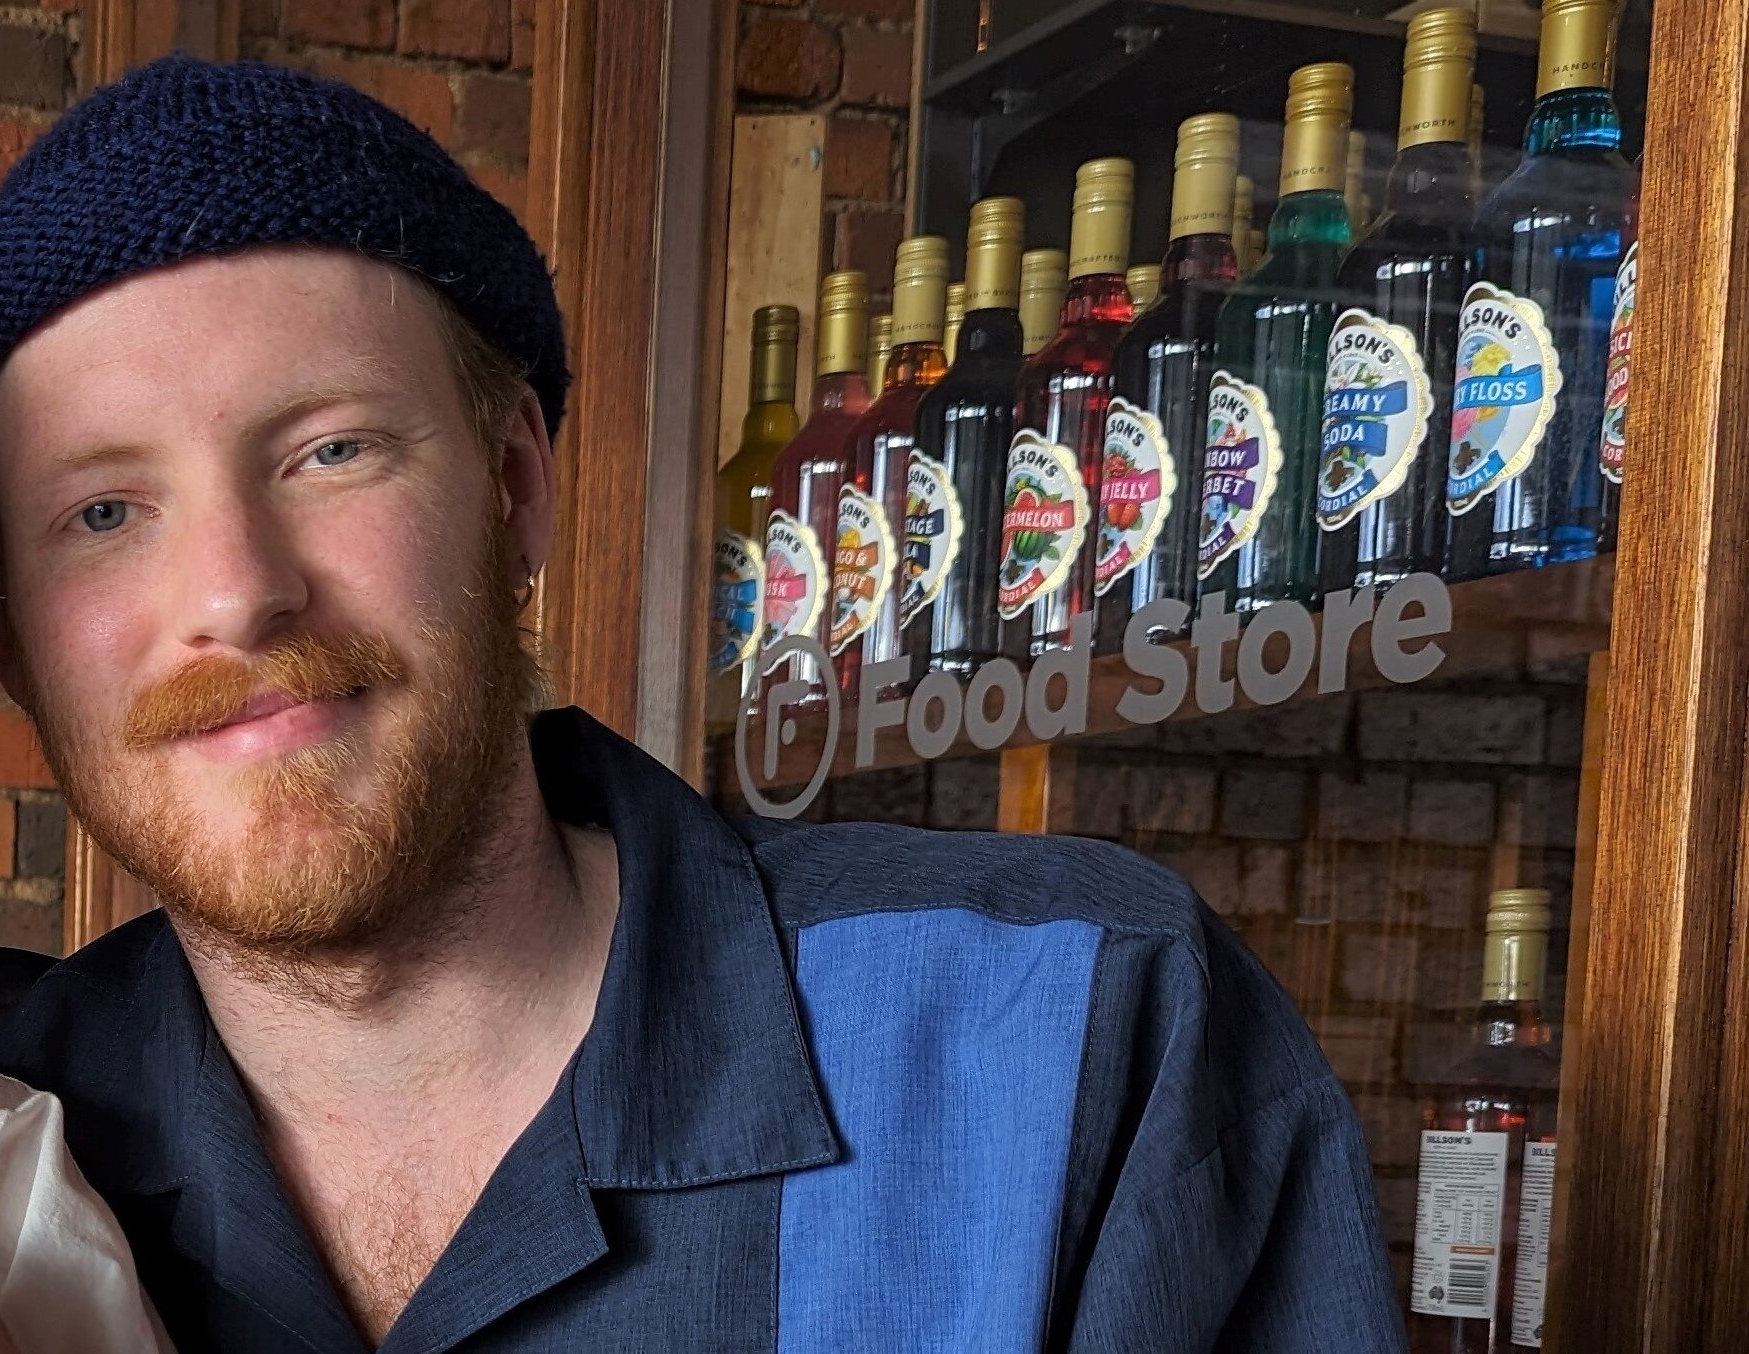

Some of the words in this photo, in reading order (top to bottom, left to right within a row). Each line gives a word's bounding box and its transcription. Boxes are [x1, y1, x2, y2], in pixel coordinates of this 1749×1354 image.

[1470, 380, 1527, 401] FLOSS
[1324, 424, 1365, 450] SODA
[908, 469, 936, 496] SON'S
[1110, 482, 1149, 501] JELLY
[855, 610, 1094, 769] Food
[1116, 572, 1452, 725] Store
